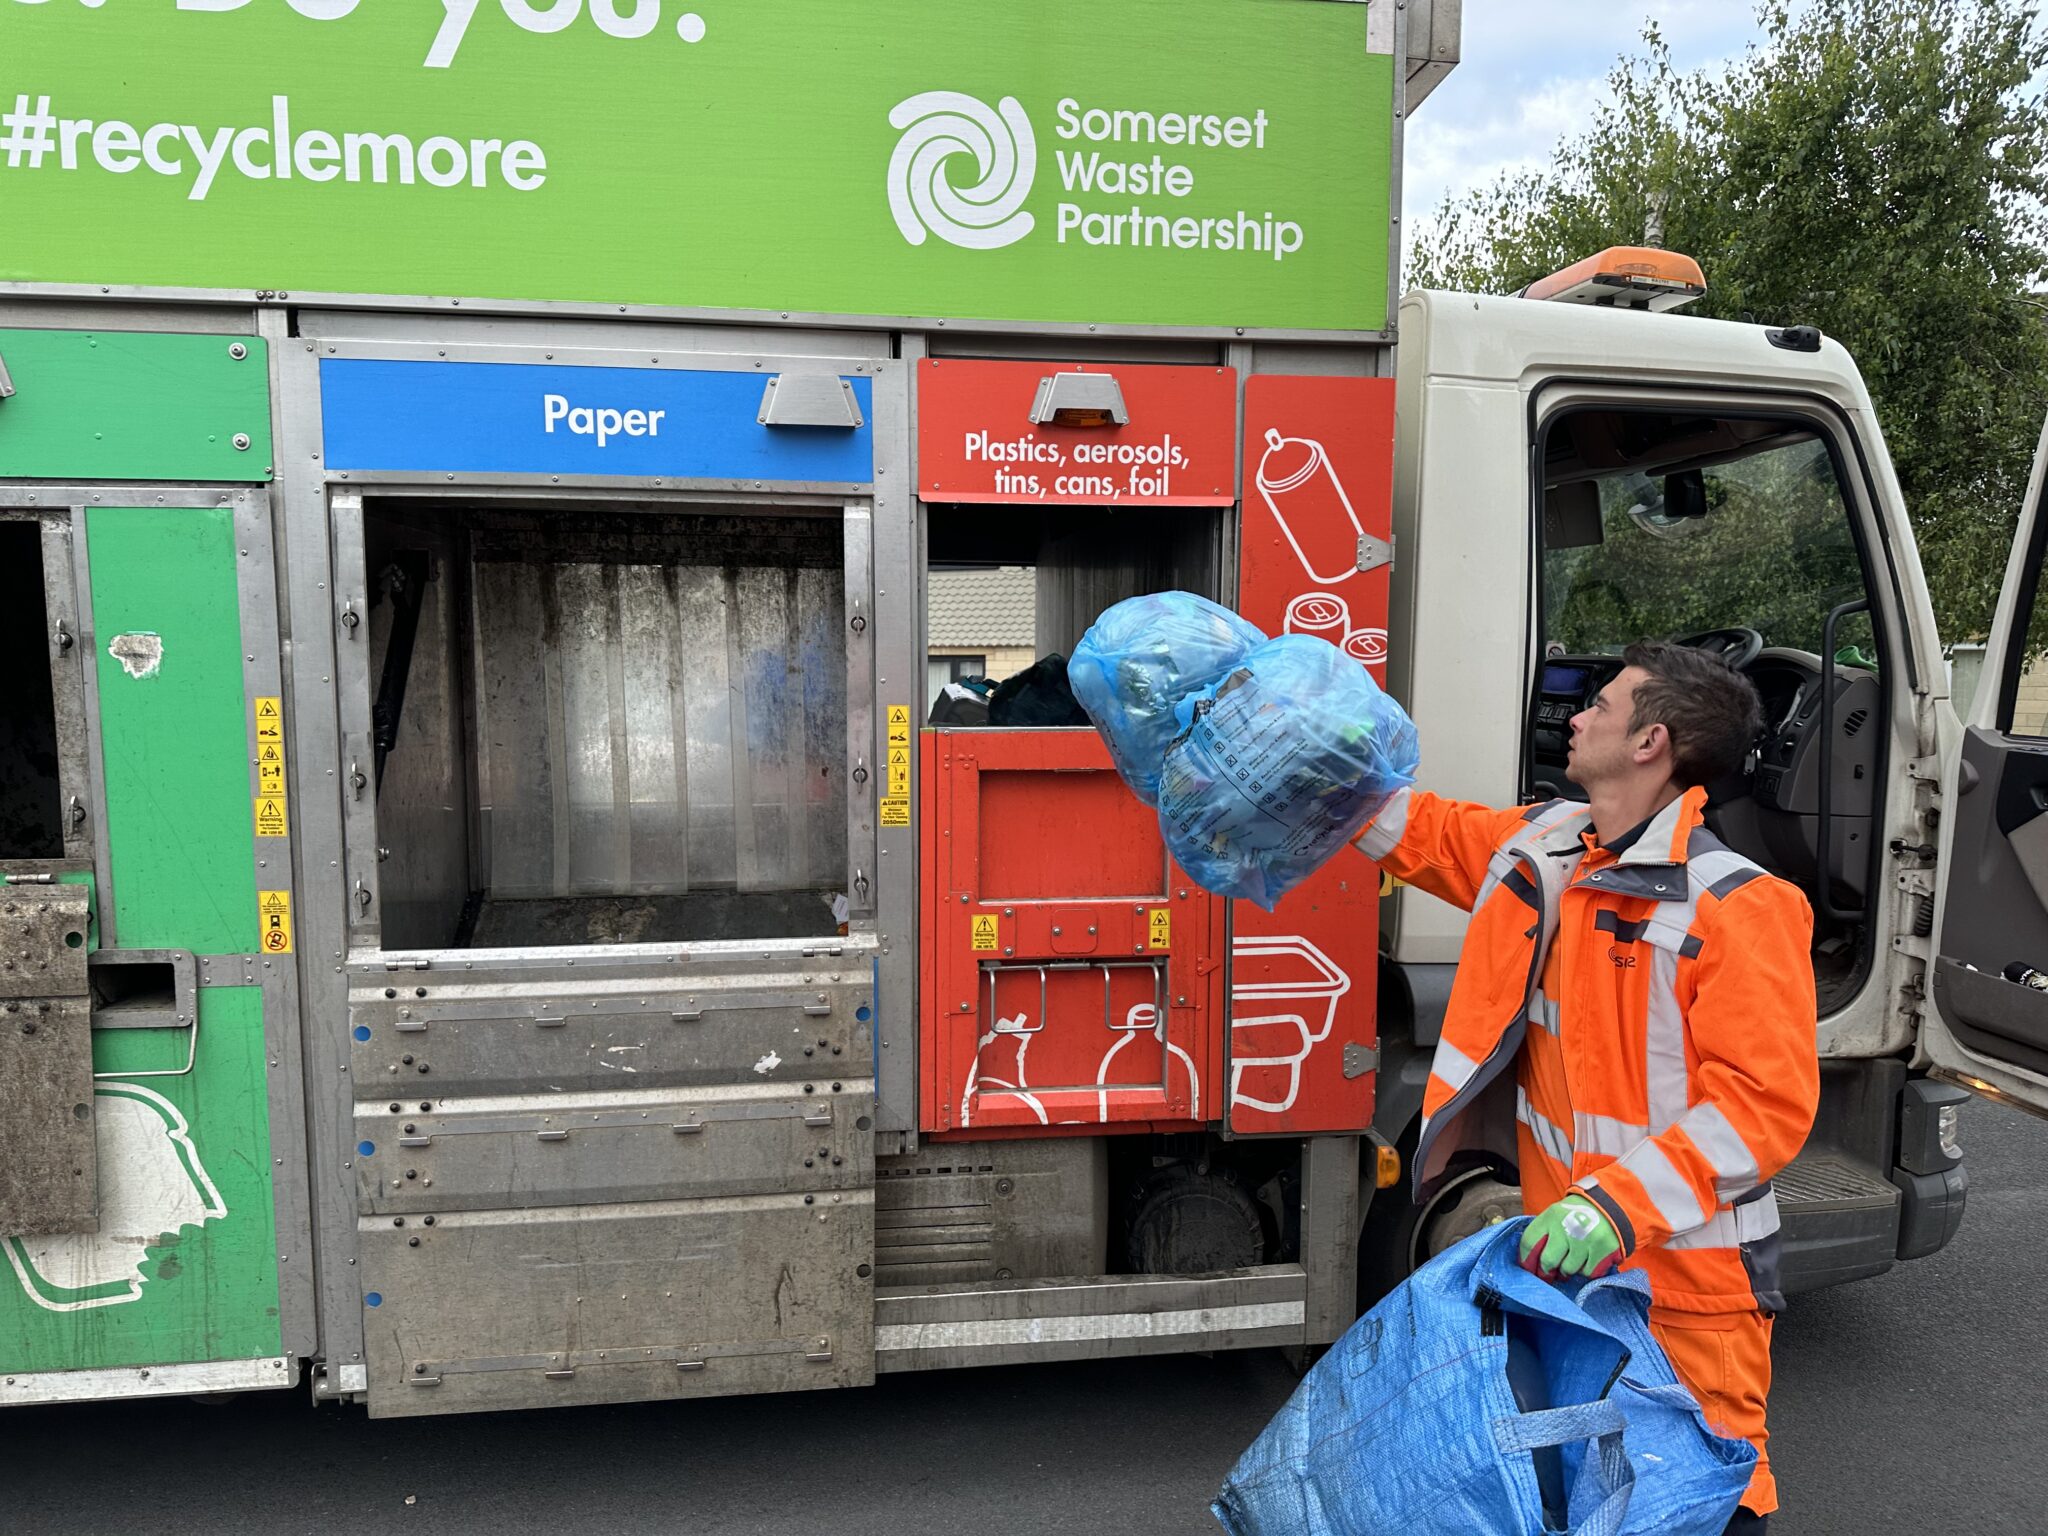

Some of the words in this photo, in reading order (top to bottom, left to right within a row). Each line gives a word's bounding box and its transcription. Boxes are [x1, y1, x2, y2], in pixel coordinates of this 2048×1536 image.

[0, 94, 547, 200] #recyclemore
[1055, 97, 1269, 149] Somerset
[1055, 150, 1194, 197] Waste
[1057, 202, 1304, 261] Partnership
[544, 394, 665, 447] Paper
[965, 429, 1067, 468] Plastics,
[1073, 433, 1189, 470] aerosols,
[994, 465, 1047, 500] tins,
[1054, 475, 1121, 501] cans,
[1129, 465, 1169, 497] foil
